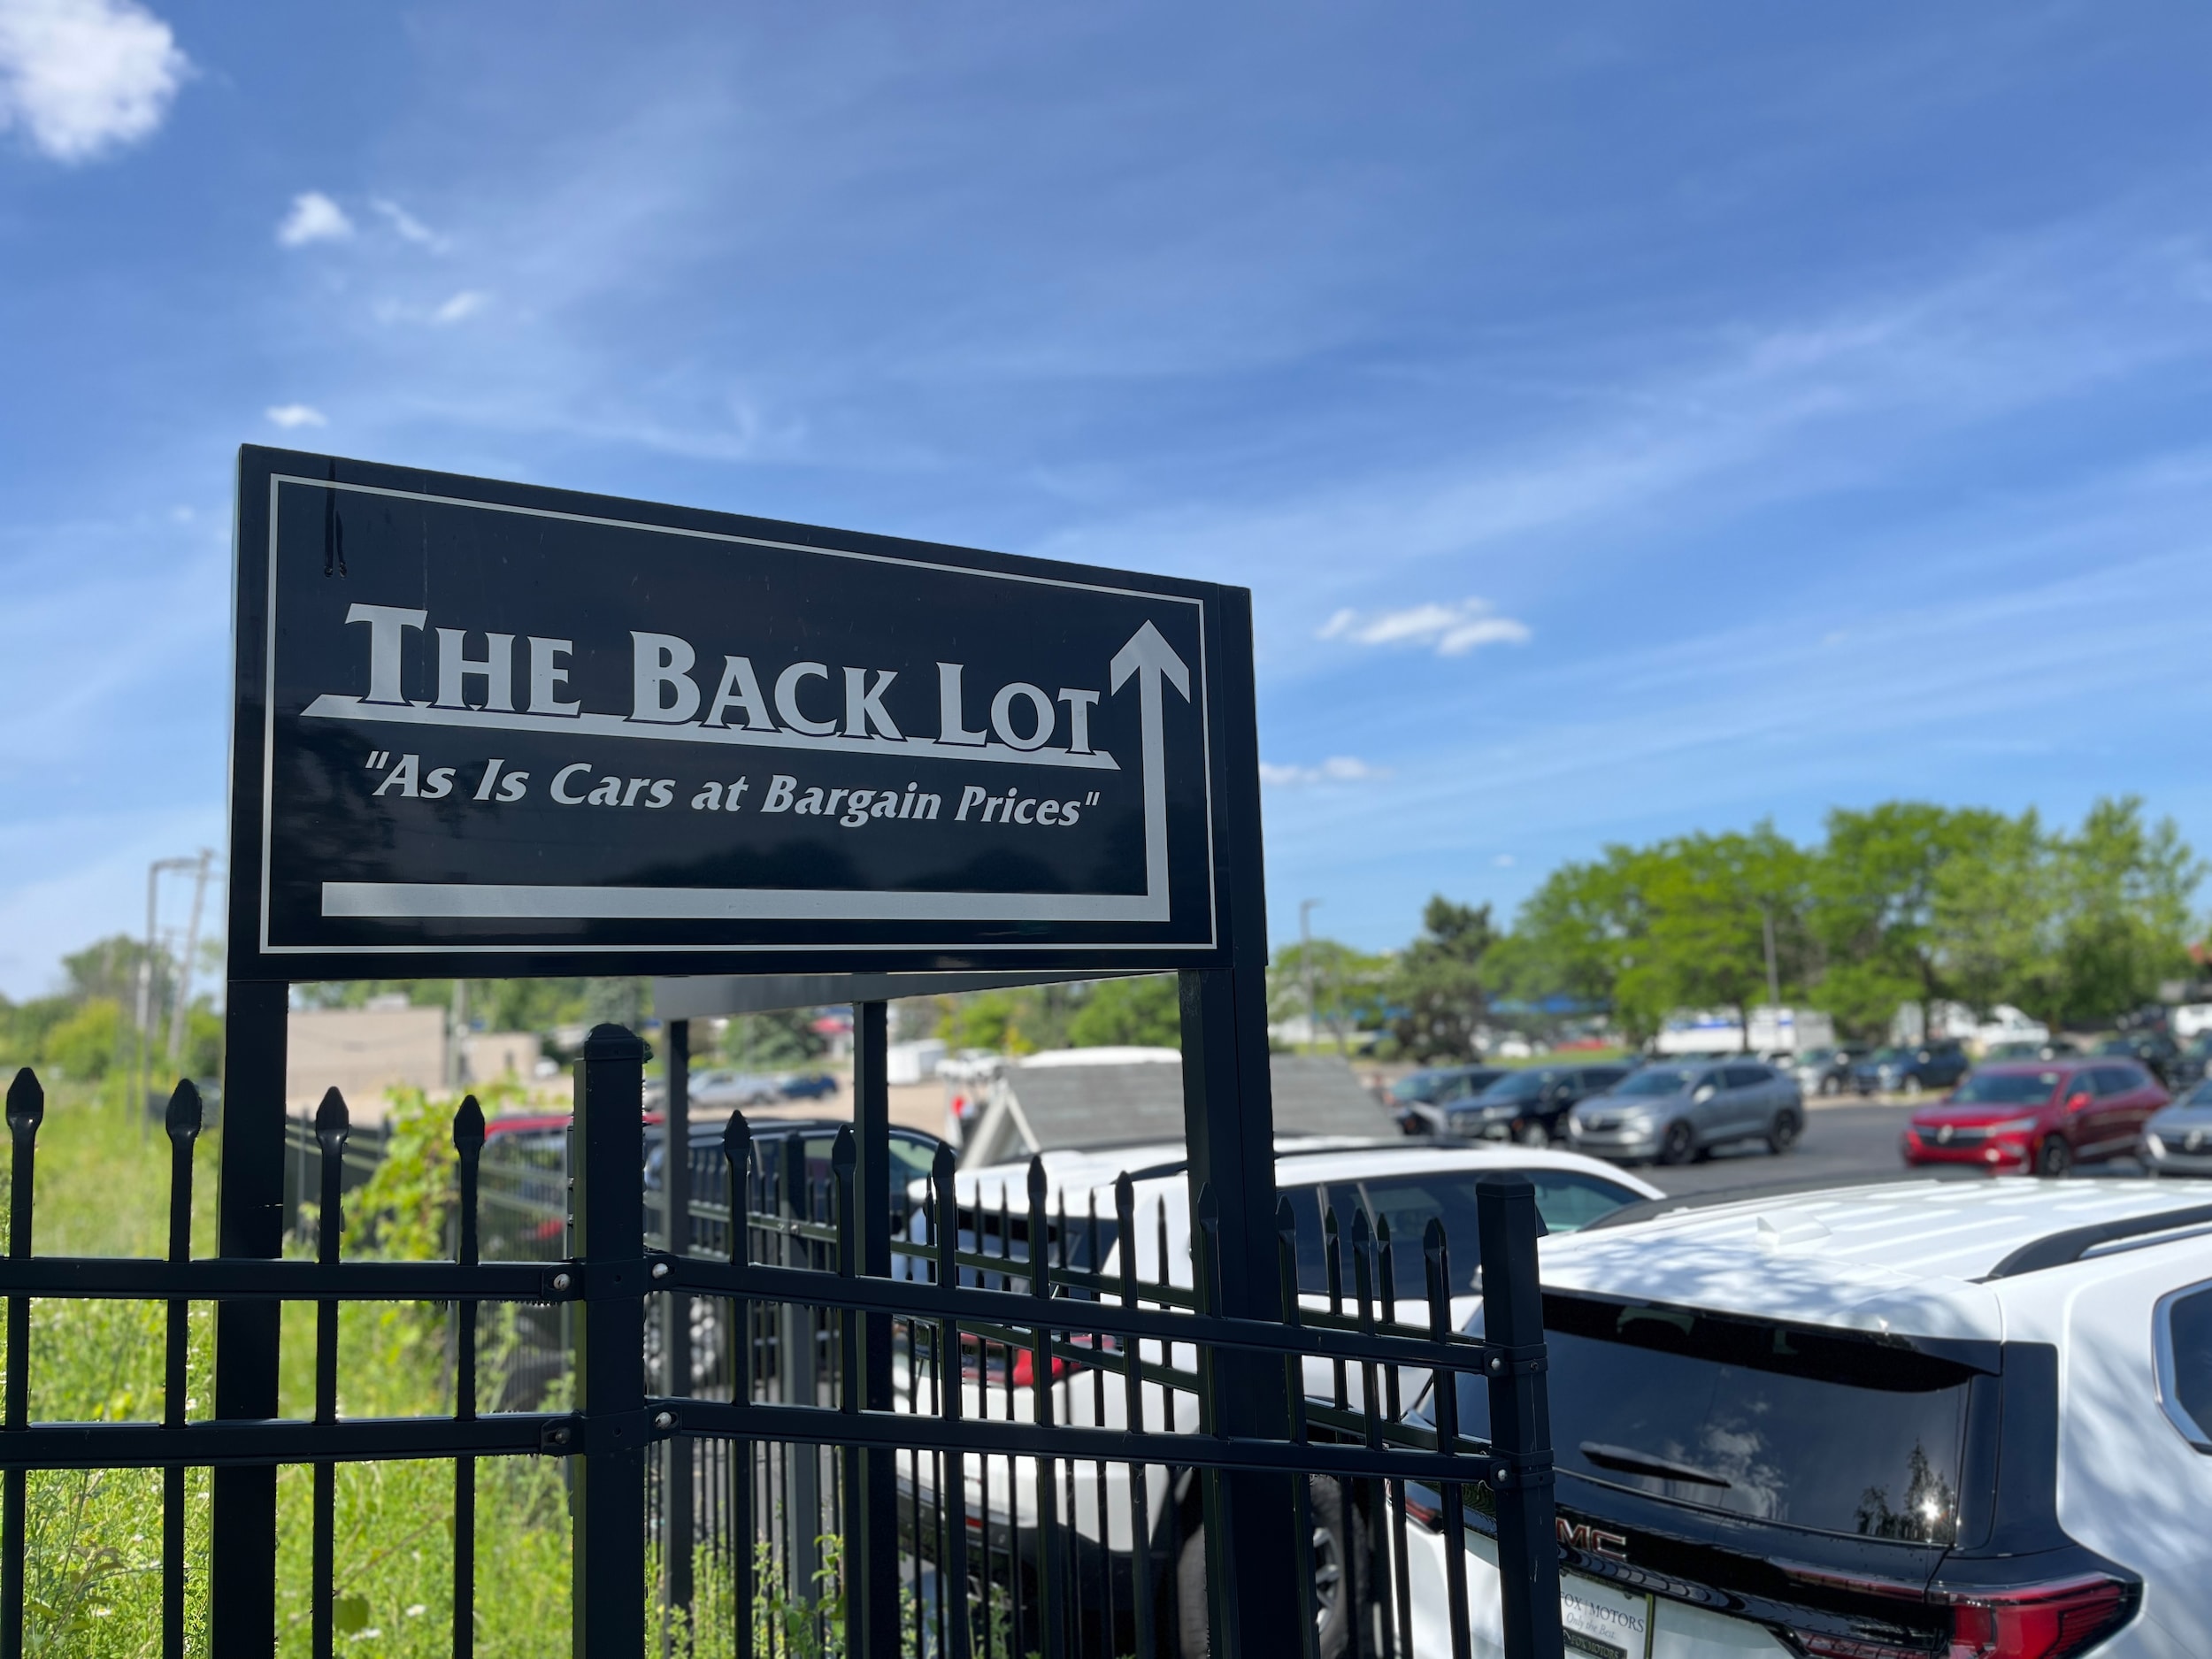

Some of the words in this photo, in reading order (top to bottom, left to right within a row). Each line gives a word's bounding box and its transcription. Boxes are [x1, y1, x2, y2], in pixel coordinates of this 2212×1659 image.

[344, 603, 581, 717] THE
[623, 630, 908, 741] BACK
[933, 662, 1101, 756] LOT
[365, 750, 457, 799] "As
[472, 758, 530, 802] Is
[549, 763, 676, 809] Cars
[691, 776, 749, 812] at
[760, 774, 941, 828] Bargain
[954, 785, 1101, 826] Prices"
[1555, 1517, 1627, 1563] MC
[1566, 1612, 1584, 1630] Only
[1586, 1620, 1598, 1632] the
[1590, 1602, 1645, 1633] MOTORS
[1571, 1635, 1586, 1648] FOX
[1587, 1640, 1619, 1659] MOTORS
